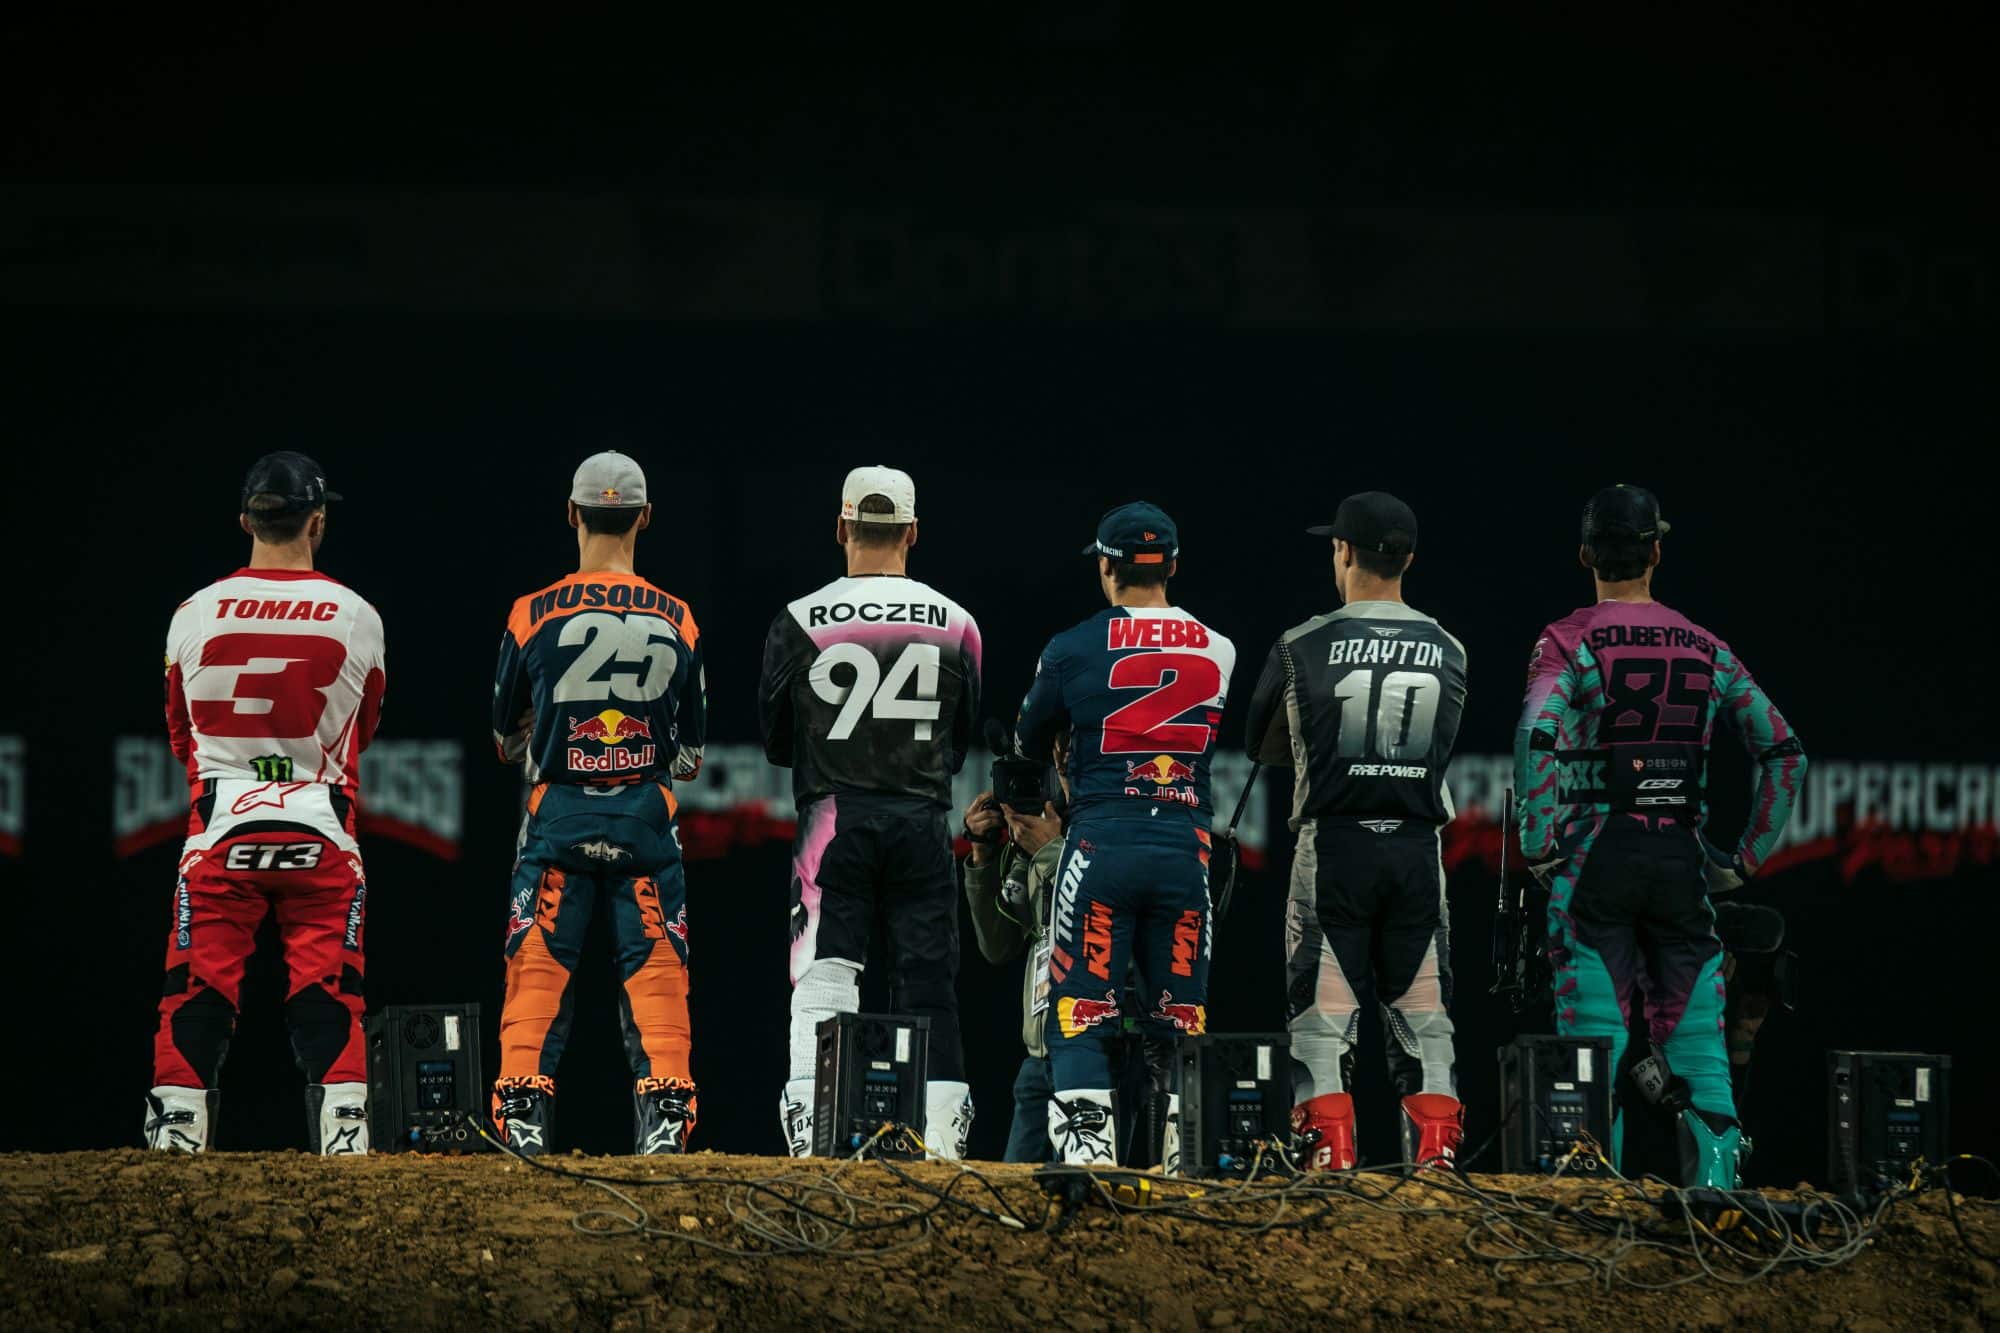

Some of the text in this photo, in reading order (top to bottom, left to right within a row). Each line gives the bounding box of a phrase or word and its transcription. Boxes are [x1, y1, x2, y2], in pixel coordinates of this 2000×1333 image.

[215, 598, 339, 622] TOMAC
[529, 583, 686, 627] MUSQUIN
[808, 602, 948, 628] ROCZEN
[1108, 617, 1210, 650] WEBB
[553, 612, 678, 704] 25
[1328, 640, 1443, 669] BRAYTON
[1591, 625, 1711, 653] SOUBEYRAS
[191, 633, 347, 739] 3
[808, 642, 942, 741] 94
[1100, 652, 1221, 754] 2
[1334, 669, 1441, 760] 10
[1601, 658, 1712, 744] 85
[226, 843, 322, 869] ET3
[178, 881, 192, 931] YAMAHA
[1055, 849, 1091, 943] THOR
[1083, 900, 1113, 981] KTM
[1171, 910, 1201, 977] KTM
